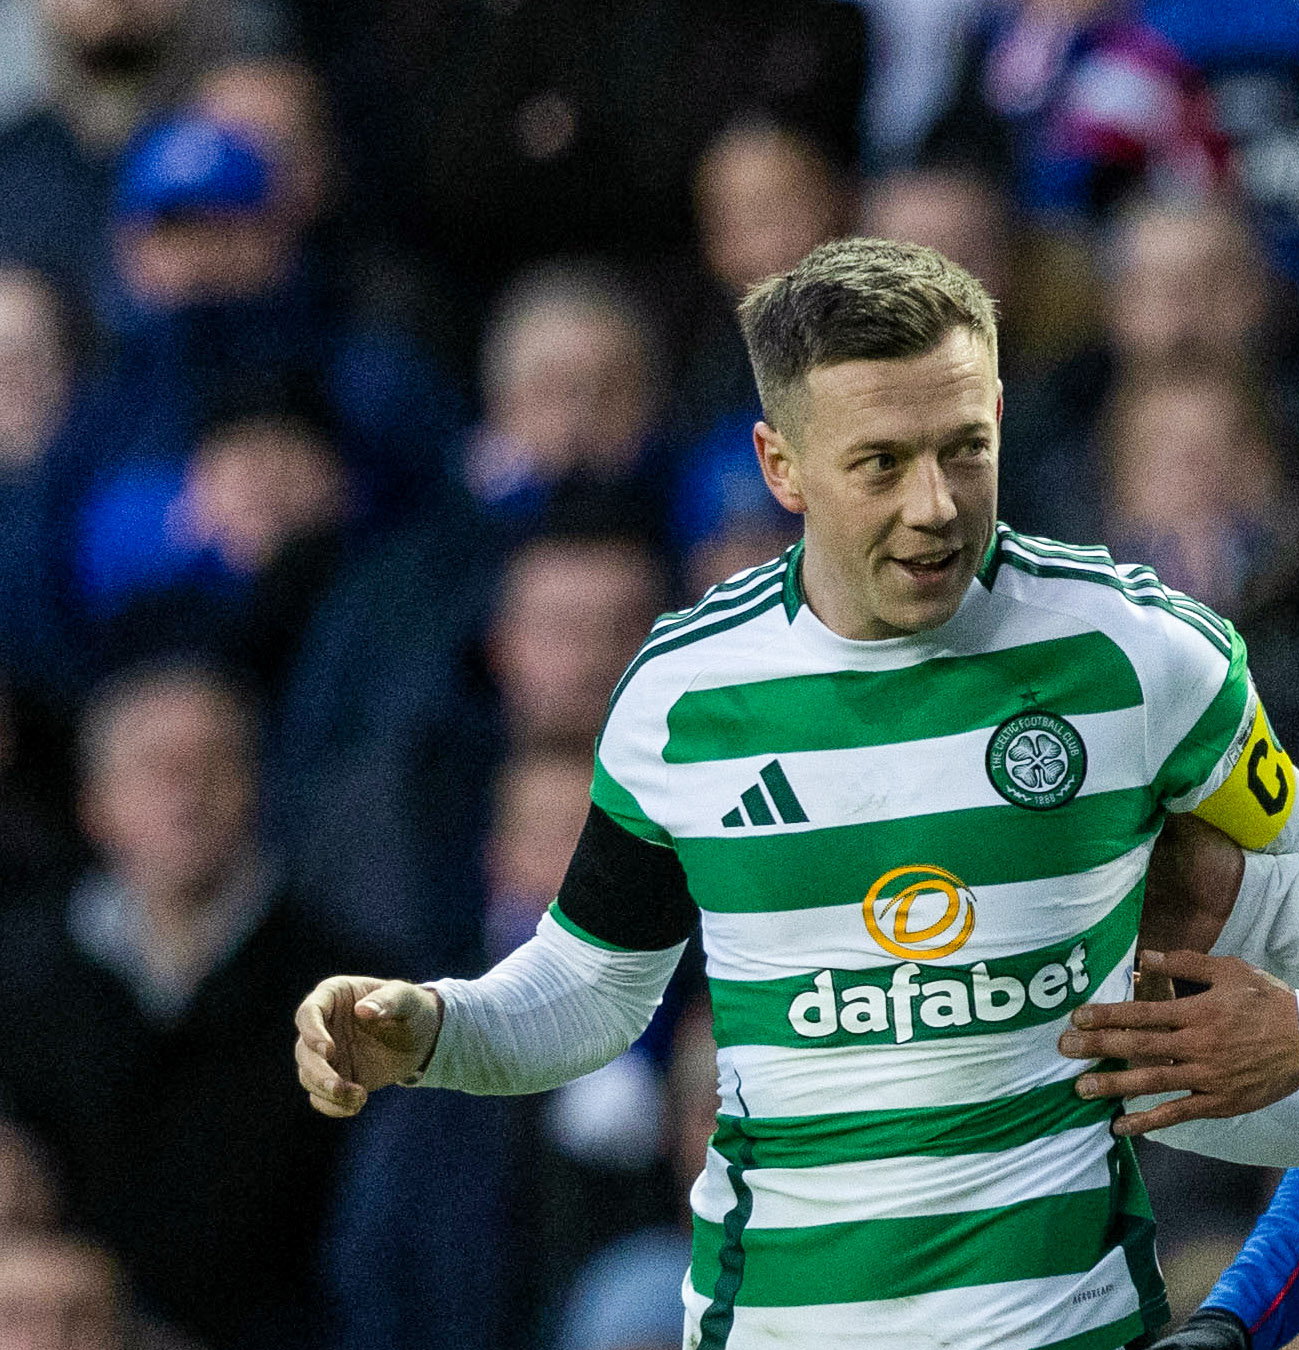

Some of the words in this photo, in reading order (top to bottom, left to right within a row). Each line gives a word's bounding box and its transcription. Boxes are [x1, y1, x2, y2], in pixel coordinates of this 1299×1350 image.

[991, 751, 1002, 771] THE
[997, 722, 1020, 749] CELTIC
[1018, 716, 1064, 736] FOOTBALL
[1063, 731, 1080, 757] CLUB
[1247, 738, 1289, 817] C
[787, 940, 1091, 1045] dafabet
